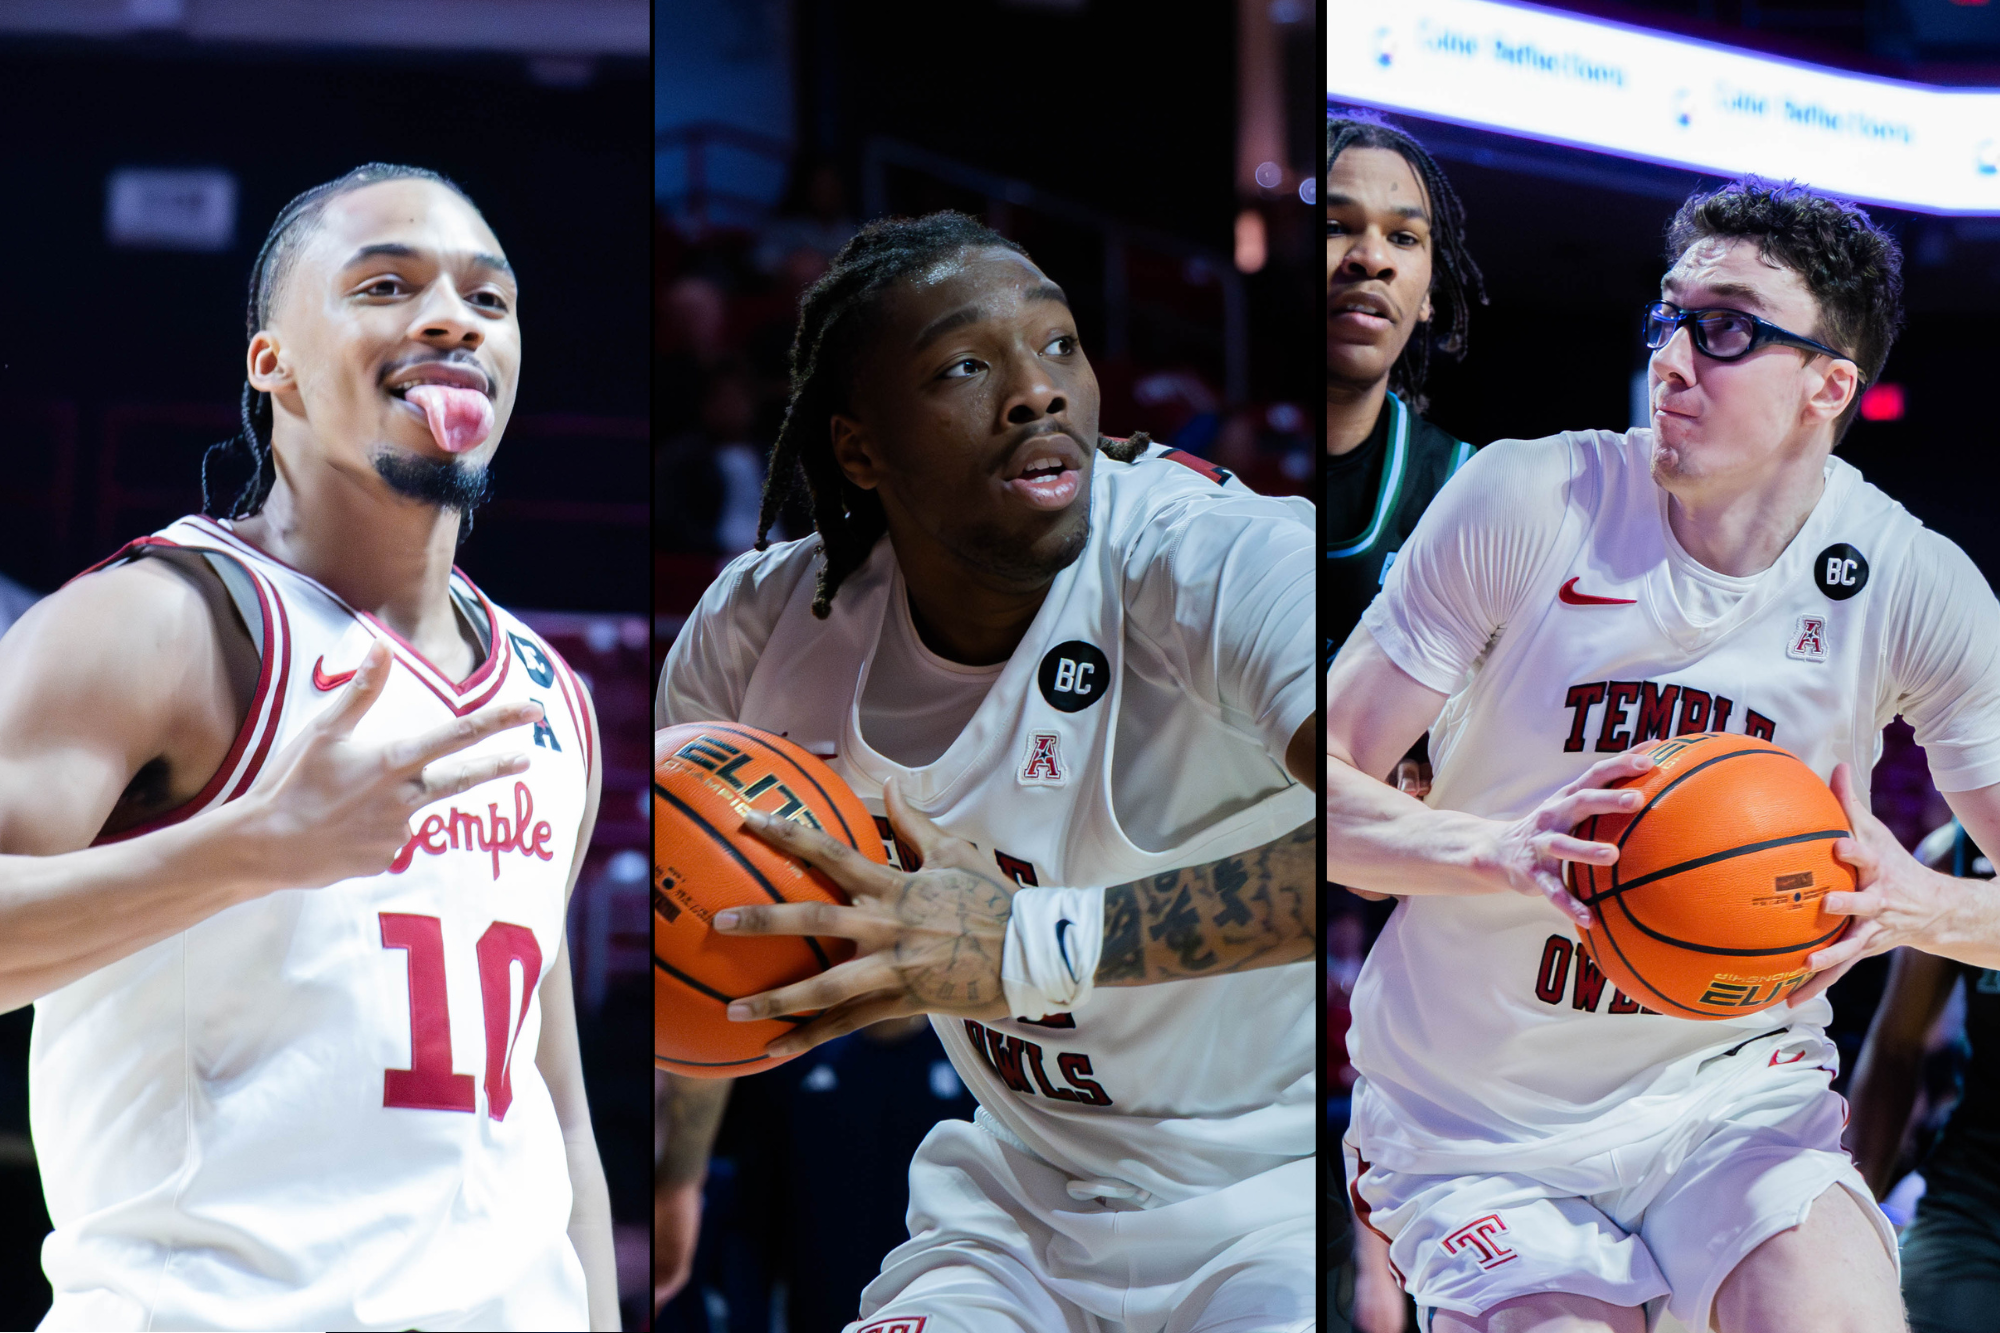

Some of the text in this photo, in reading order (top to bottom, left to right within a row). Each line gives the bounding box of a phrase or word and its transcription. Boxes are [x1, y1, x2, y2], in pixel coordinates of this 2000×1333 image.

[1826, 557, 1857, 586] BC
[1794, 619, 1823, 655] A
[1054, 657, 1095, 695] BC
[1024, 735, 1061, 779] A
[386, 781, 554, 881] emple
[1535, 933, 1664, 1015] OW
[1698, 973, 1812, 1007] ELIT
[378, 911, 543, 1123] 10
[964, 1019, 1113, 1107] OWLS
[1441, 1213, 1518, 1270] T
